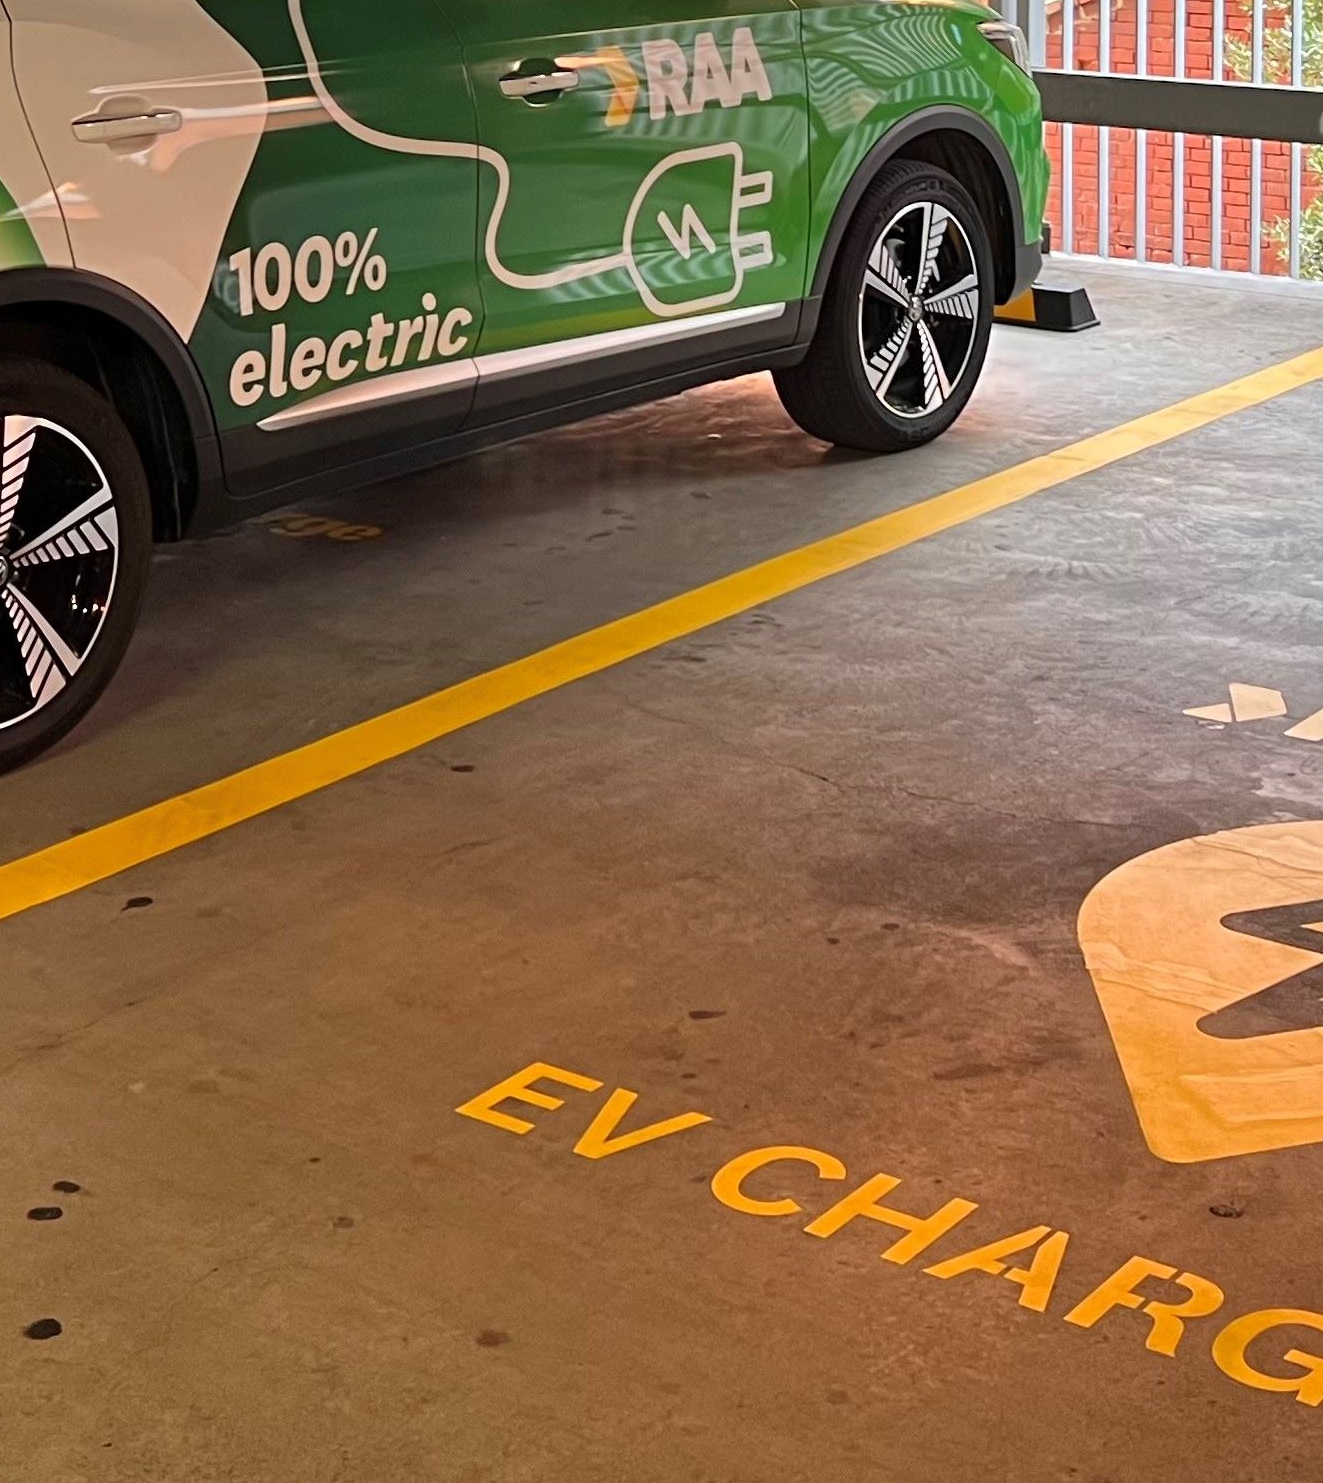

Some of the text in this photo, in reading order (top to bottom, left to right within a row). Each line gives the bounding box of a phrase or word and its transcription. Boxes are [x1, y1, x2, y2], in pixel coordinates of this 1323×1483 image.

[642, 26, 773, 121] RAA
[228, 228, 387, 317] 100%
[229, 292, 474, 408] electric
[453, 1061, 714, 1160] EV
